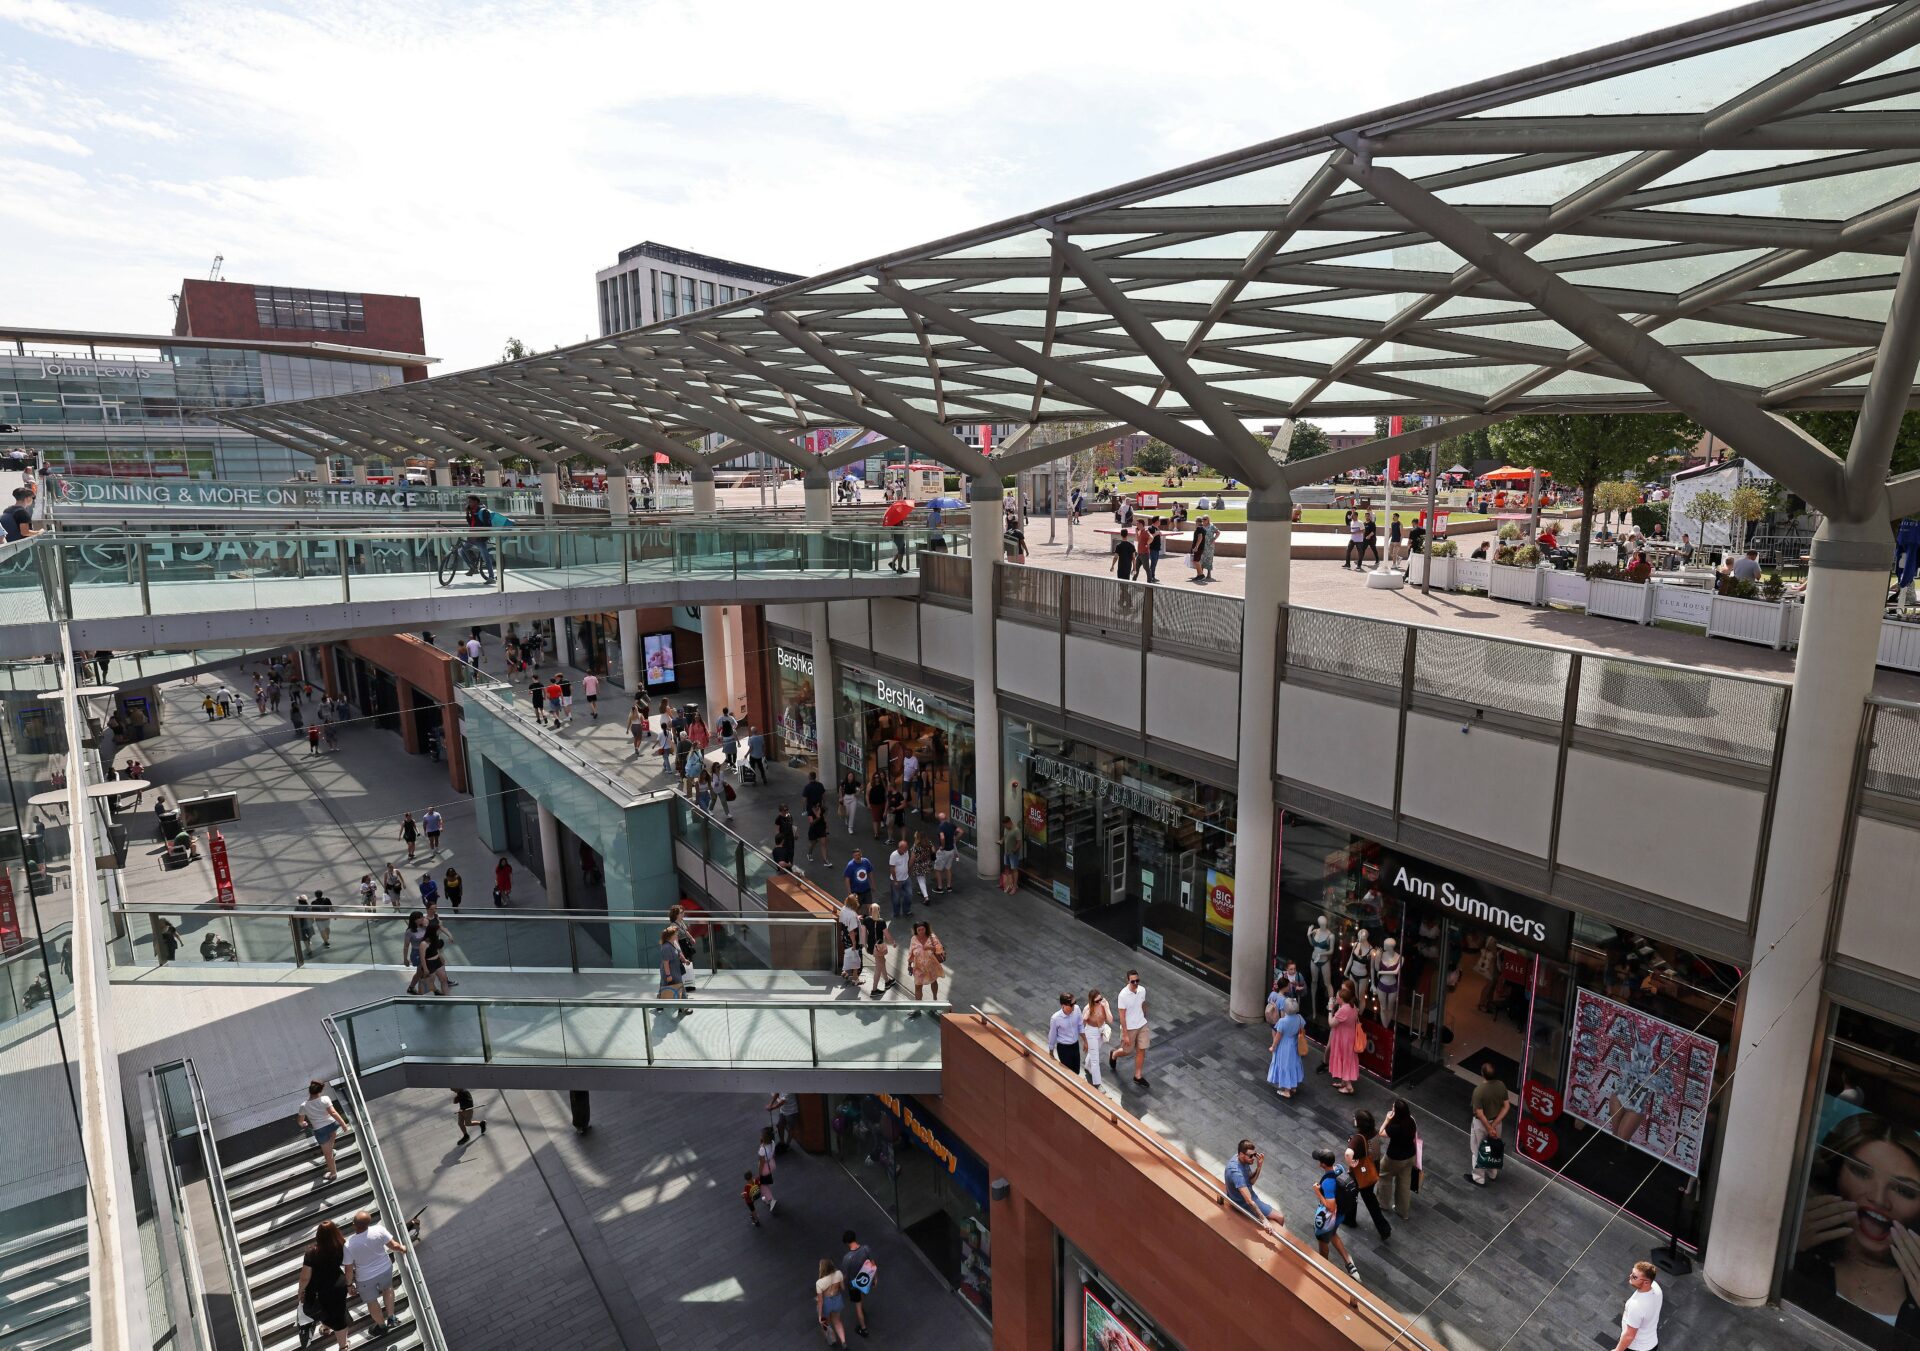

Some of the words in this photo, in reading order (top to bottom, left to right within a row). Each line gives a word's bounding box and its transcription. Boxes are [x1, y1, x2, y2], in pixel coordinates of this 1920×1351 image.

[40, 360, 89, 379] John
[94, 361, 150, 379] Lewis
[88, 484, 171, 502] DINING
[178, 488, 193, 502] &
[200, 488, 260, 504] MORE
[267, 490, 297, 504] ON
[304, 490, 323, 498] THE
[327, 490, 417, 507] TERRACE
[1683, 602, 1711, 611] HOUSE
[777, 647, 813, 676] Bershka
[877, 679, 925, 715] Bershka
[1035, 755, 1094, 793] HOLLAND
[1112, 783, 1183, 829] BARRETT
[965, 812, 976, 827] OFF
[1030, 807, 1041, 819] BIG
[1216, 889, 1231, 904] BIG
[1393, 866, 1435, 901] Ann
[1440, 882, 1546, 942] Summers
[1505, 962, 1525, 974] SALE
[1529, 1096, 1554, 1117] £3
[904, 1106, 957, 1174] Factory
[1527, 1124, 1549, 1141] BRAS
[1527, 1136, 1549, 1153] £7
